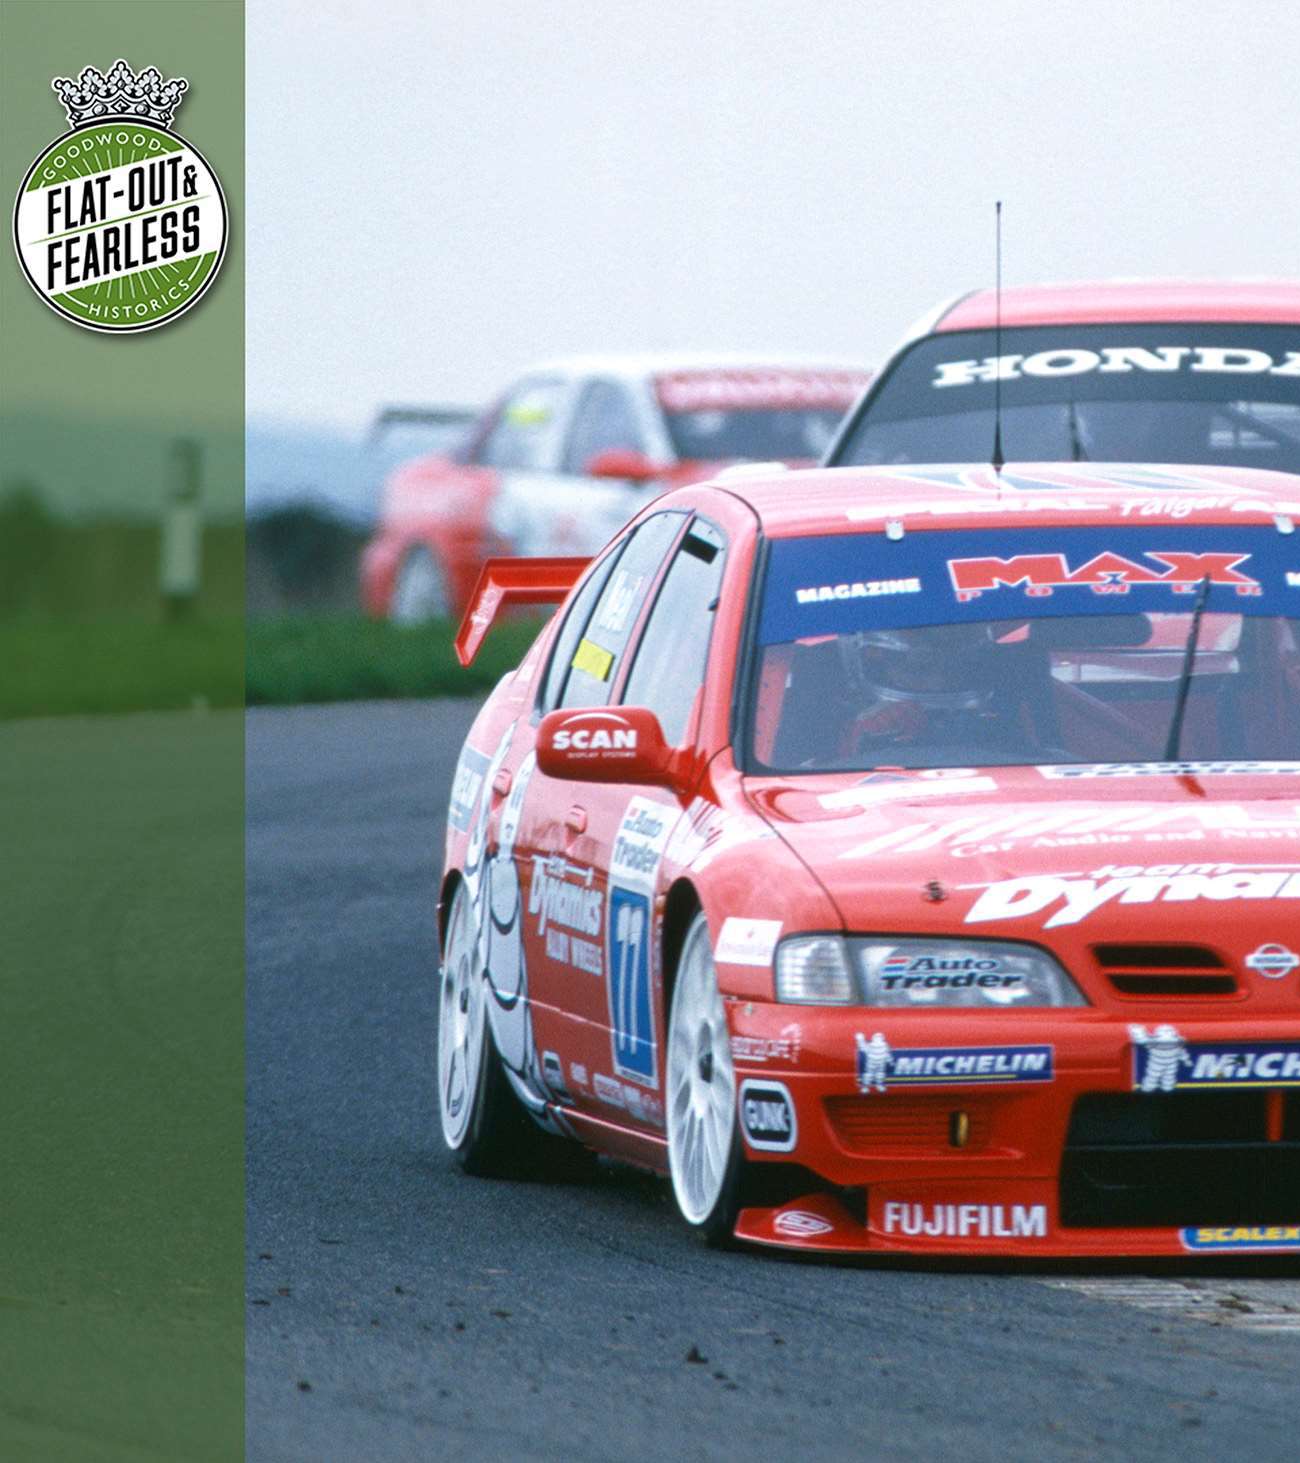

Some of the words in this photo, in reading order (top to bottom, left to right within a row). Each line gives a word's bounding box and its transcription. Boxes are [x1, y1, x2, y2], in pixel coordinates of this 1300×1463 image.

[948, 551, 1261, 592] MAX
[796, 578, 921, 603] MAGAZINE
[956, 583, 1264, 602] POWER
[552, 729, 637, 750] SCAN
[950, 841, 1015, 859] Car
[1032, 831, 1132, 848] Audio
[1143, 829, 1207, 843] and
[909, 957, 998, 971] Auto
[881, 972, 1024, 990] Trader
[893, 1053, 1047, 1075] MICHELIN
[884, 1202, 1047, 1237] FUJIFILM
